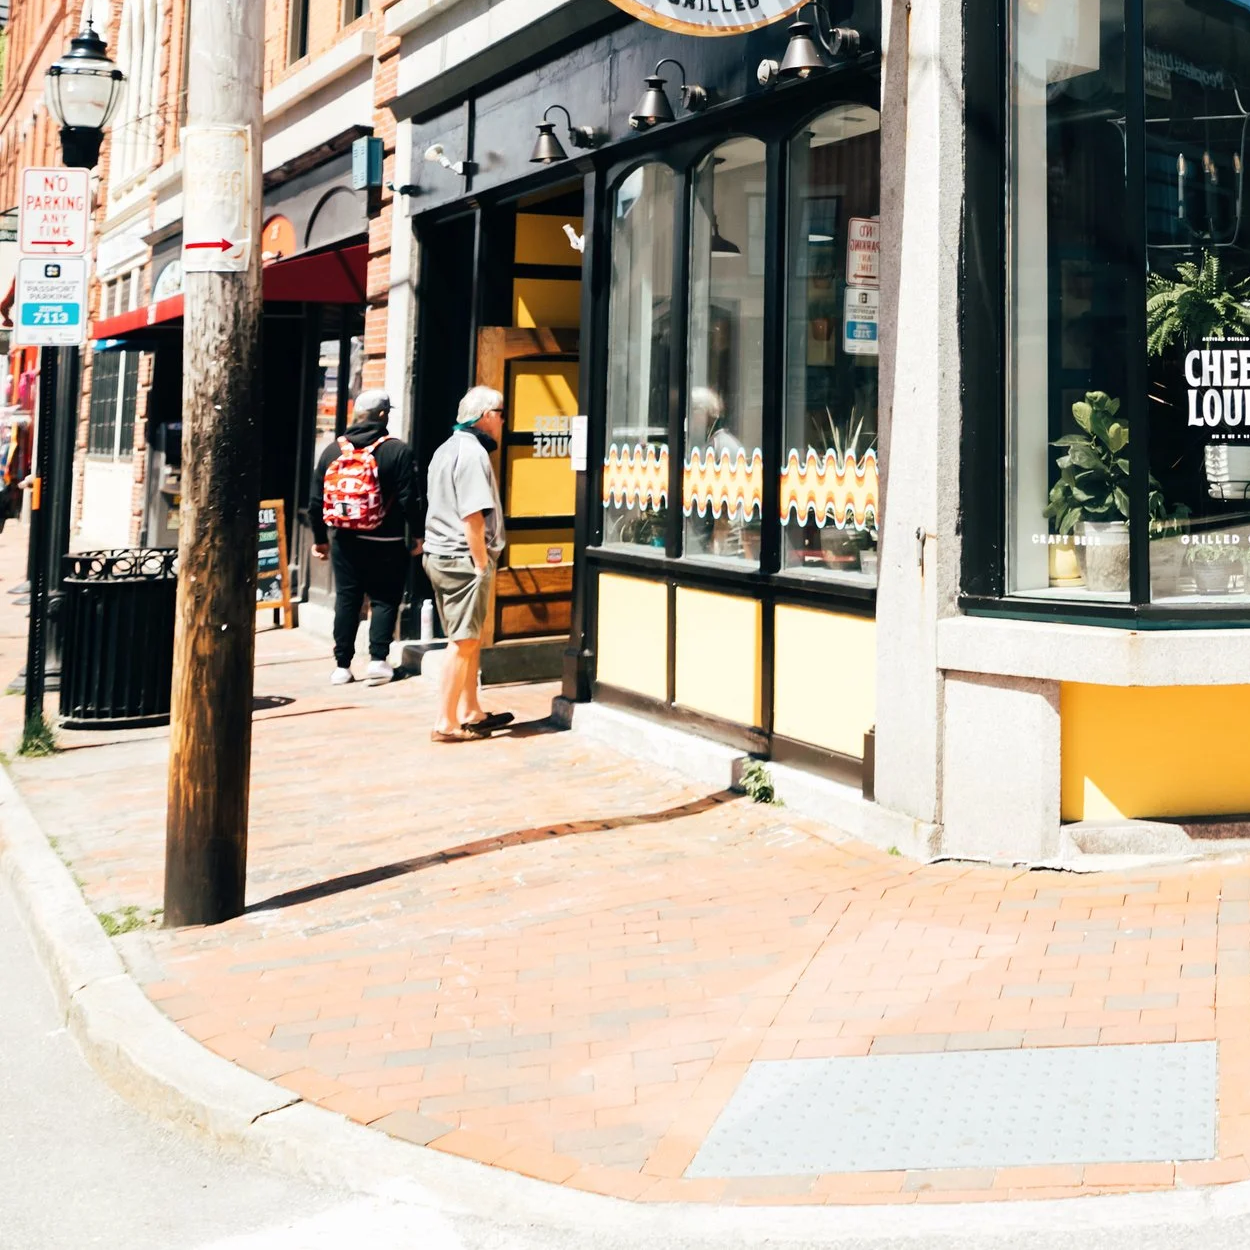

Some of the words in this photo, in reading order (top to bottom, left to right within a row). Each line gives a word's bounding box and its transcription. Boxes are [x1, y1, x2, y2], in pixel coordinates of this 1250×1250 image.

[44, 177, 68, 192] NO
[27, 196, 84, 211] PARKING
[41, 214, 68, 224] ANY
[40, 226, 69, 237] TIME
[33, 312, 69, 324] 7113
[1032, 534, 1069, 545] CRAFT
[1074, 535, 1101, 545] BEER
[1181, 534, 1240, 545] GRILLED
